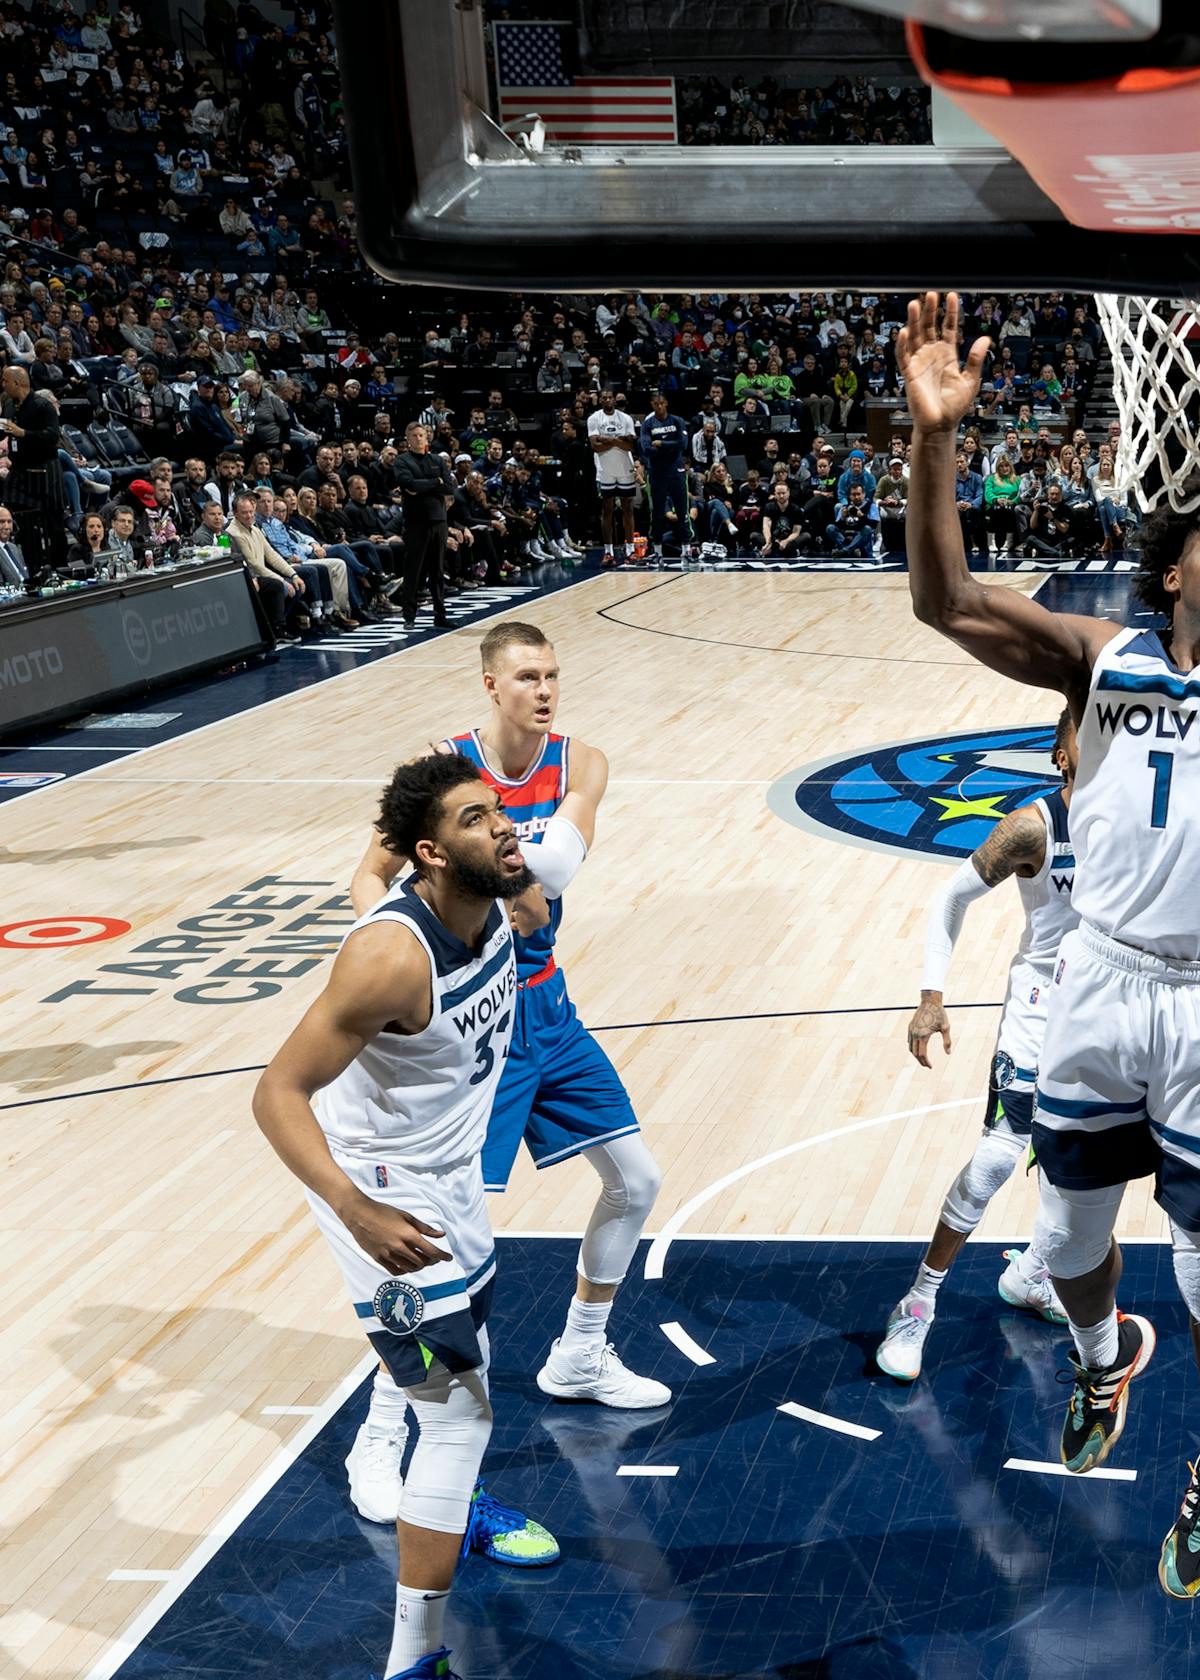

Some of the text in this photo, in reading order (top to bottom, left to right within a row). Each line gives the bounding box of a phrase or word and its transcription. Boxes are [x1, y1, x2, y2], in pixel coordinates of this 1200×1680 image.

[151, 600, 229, 644] CFMOTO
[0, 646, 64, 690] MOTO
[1148, 750, 1174, 829] 1
[38, 875, 336, 1004] TARGET
[173, 888, 358, 1005] CENT
[453, 961, 516, 1039] WOLVE
